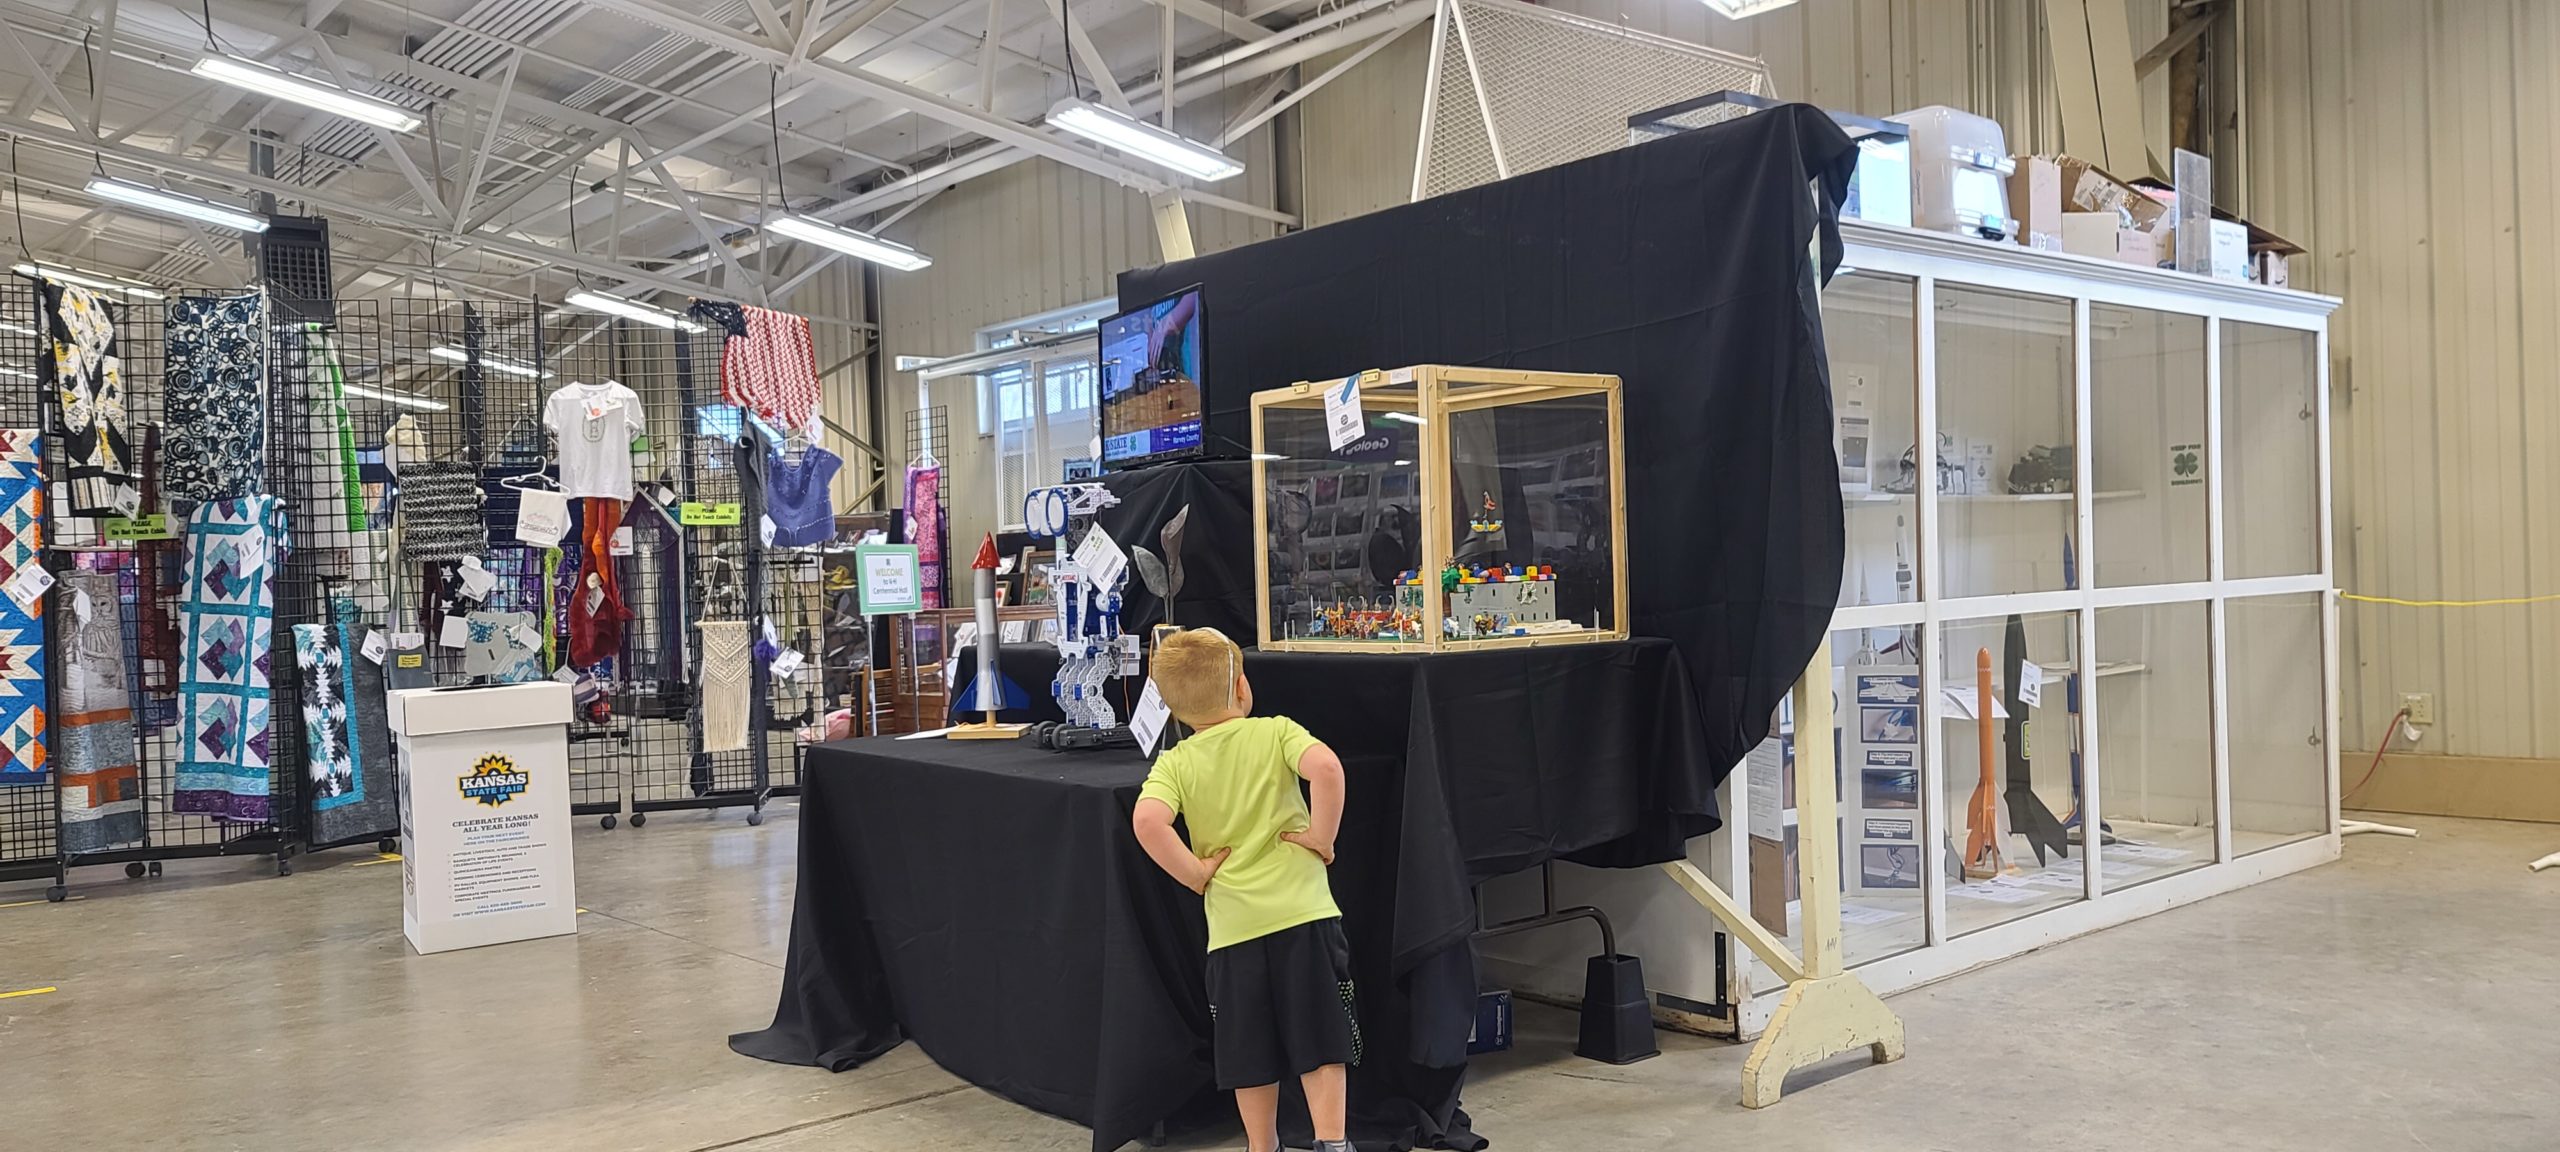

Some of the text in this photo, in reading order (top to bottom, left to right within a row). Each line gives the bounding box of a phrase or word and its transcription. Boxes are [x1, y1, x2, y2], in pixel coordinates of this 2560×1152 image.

[875, 568, 903, 576] WELCOME
[462, 774, 526, 789] KANSAS
[466, 785, 523, 796] STATE FAIR
[452, 813, 539, 827] CELEBRATE KANSAS
[481, 823, 503, 832] YEAR
[505, 821, 531, 829] LONG!
